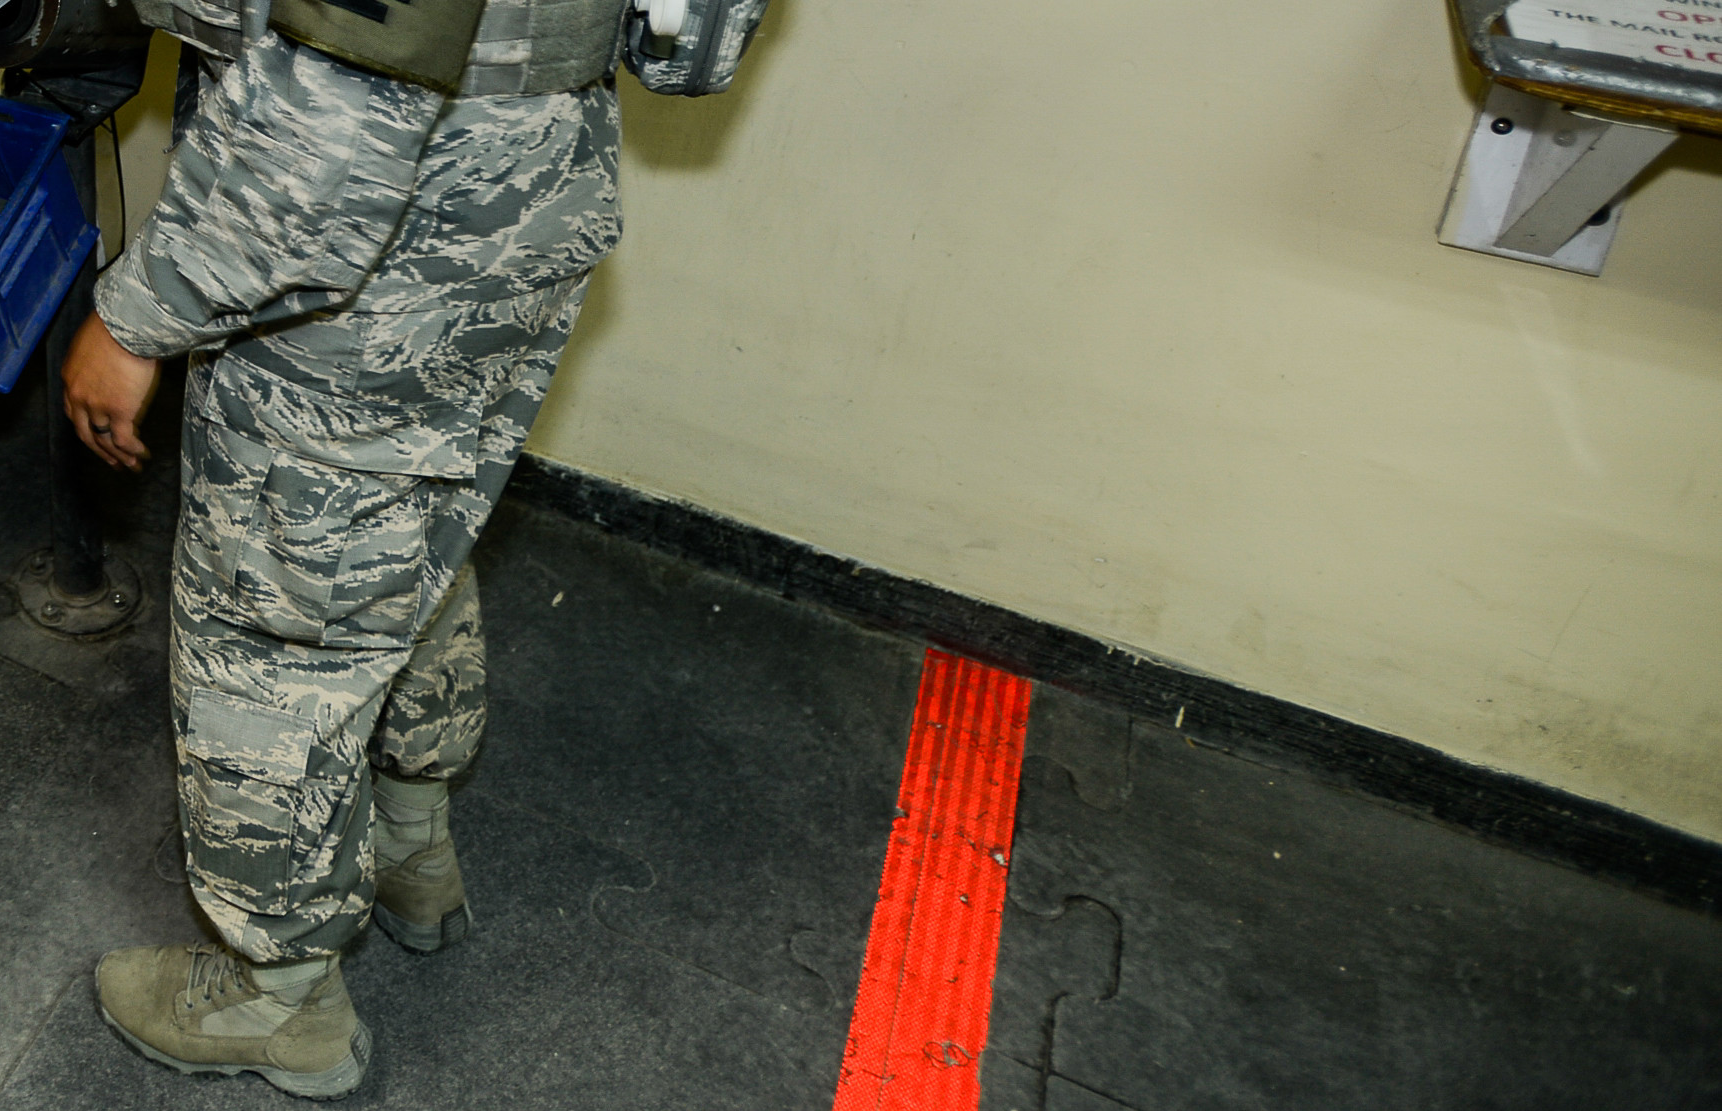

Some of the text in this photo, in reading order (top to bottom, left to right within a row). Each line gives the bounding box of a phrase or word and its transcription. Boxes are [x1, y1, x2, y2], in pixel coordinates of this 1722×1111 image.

[1547, 9, 1600, 25] THE
[1609, 20, 1686, 39] MAIL
[1657, 9, 1722, 25] OP
